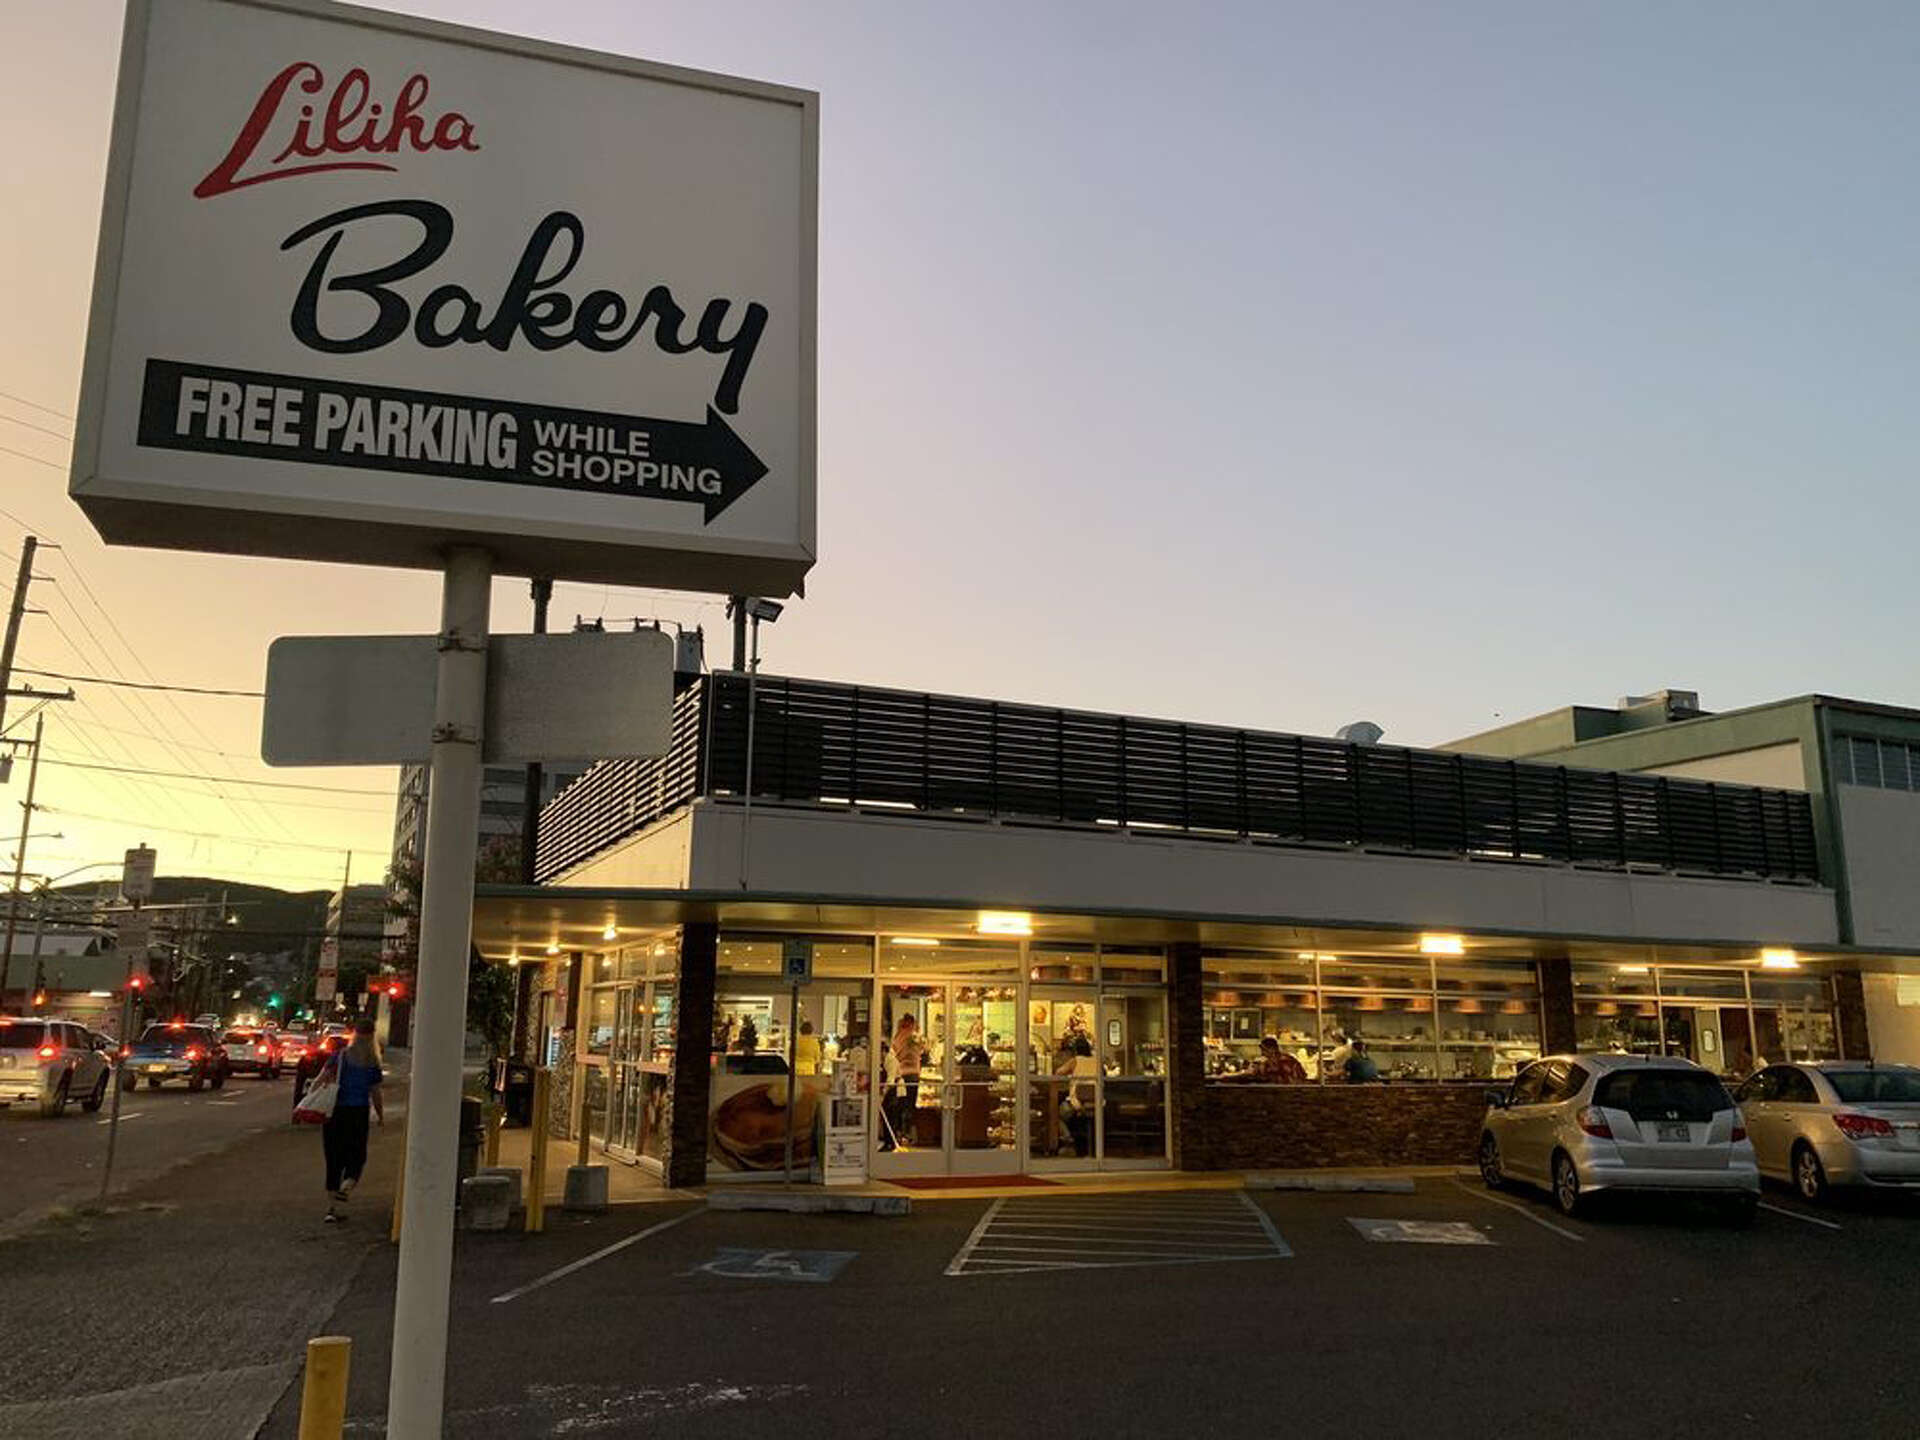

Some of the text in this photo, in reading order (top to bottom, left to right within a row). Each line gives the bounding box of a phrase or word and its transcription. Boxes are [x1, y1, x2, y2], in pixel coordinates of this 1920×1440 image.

[194, 62, 480, 200] Liliha
[280, 200, 769, 415] Bakery
[176, 377, 518, 469] FREE PARKING
[533, 419, 650, 458] WHILE
[531, 450, 722, 495] SHOPPING
